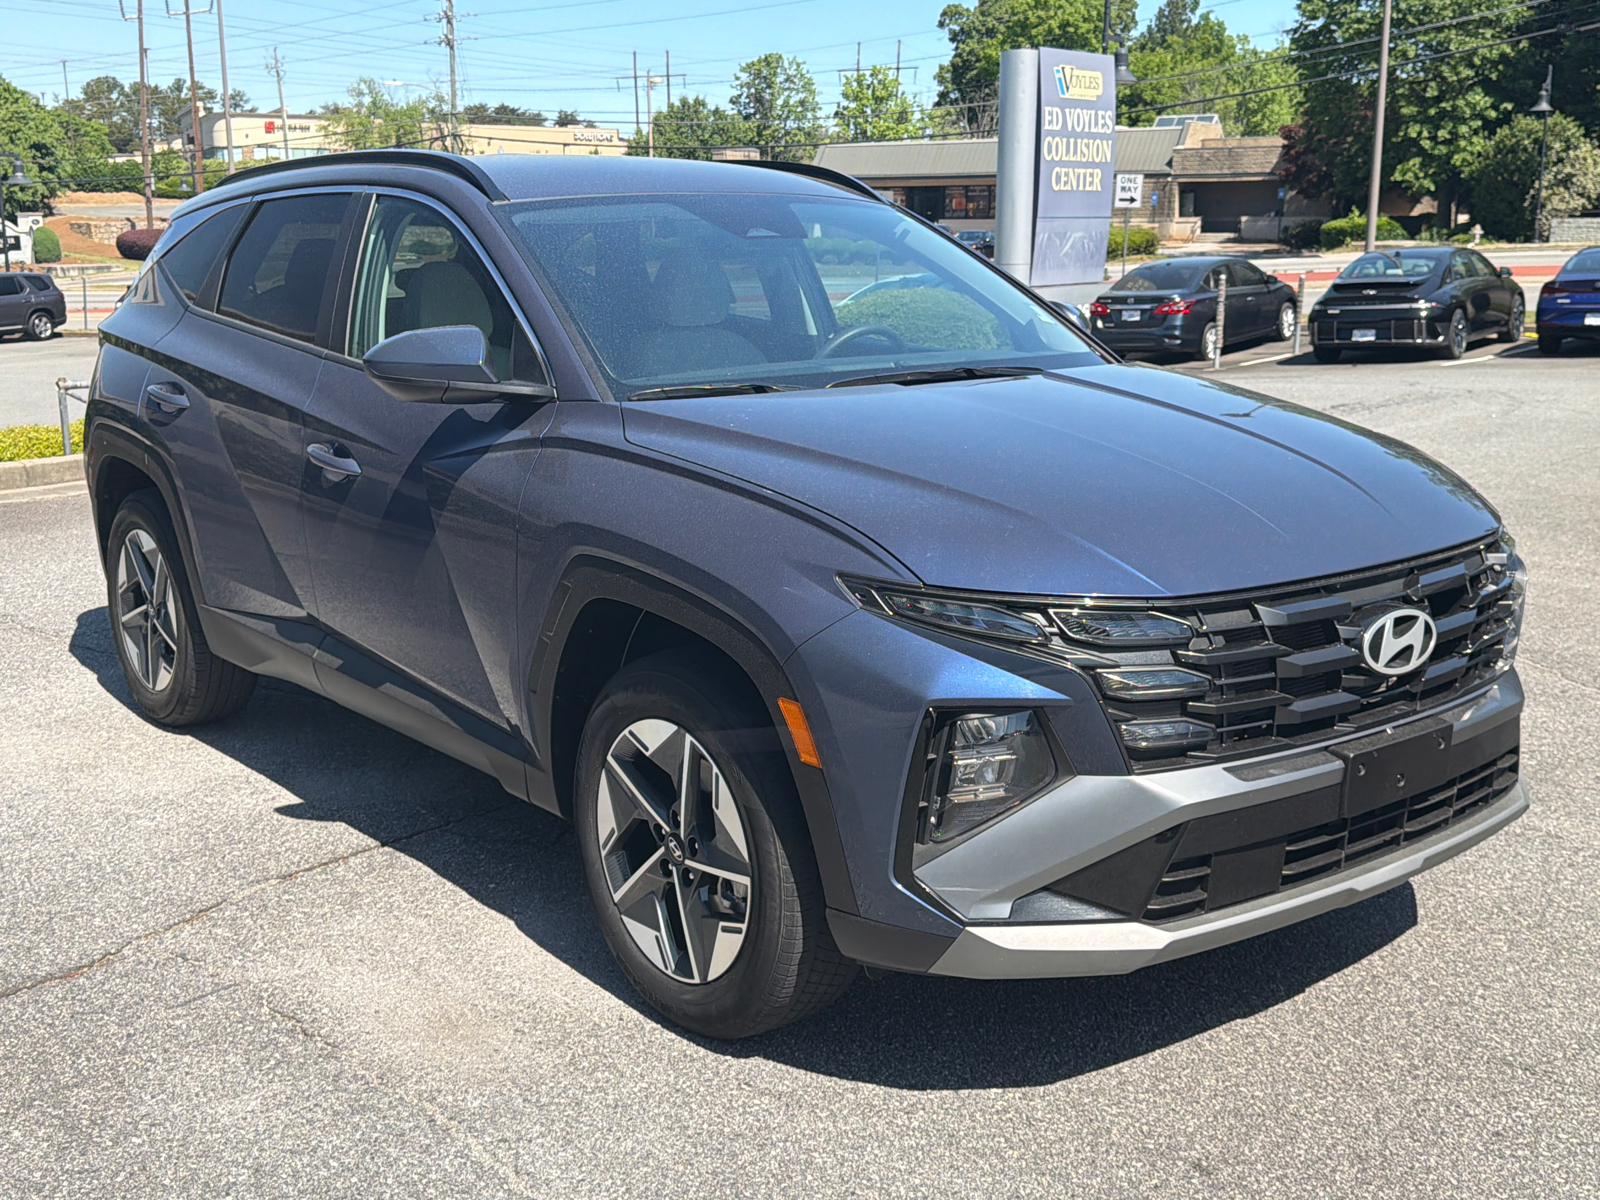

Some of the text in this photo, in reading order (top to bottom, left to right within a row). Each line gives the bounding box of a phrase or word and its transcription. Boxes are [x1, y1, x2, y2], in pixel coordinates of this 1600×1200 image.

[1044, 107, 1113, 134] ED VOYLES
[1043, 136, 1112, 163] COLLISION
[1051, 167, 1102, 192] CENTER
[1120, 176, 1138, 185] ONE
